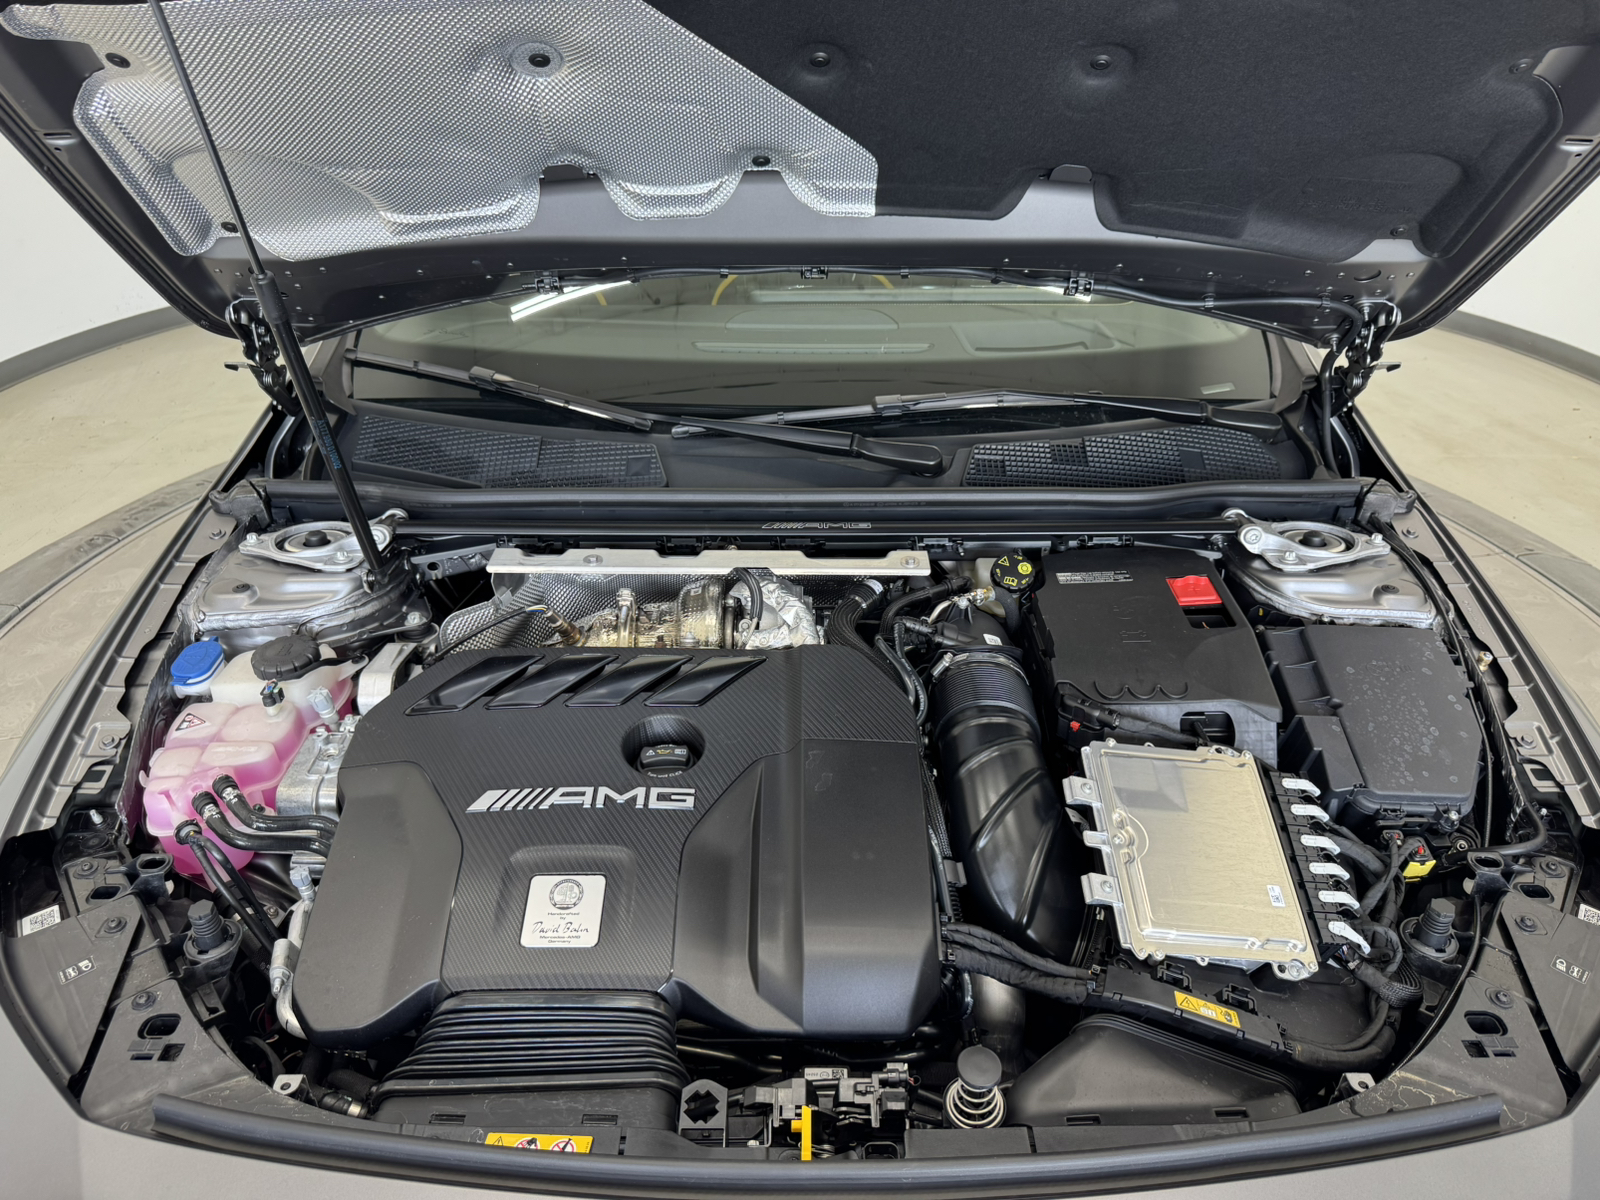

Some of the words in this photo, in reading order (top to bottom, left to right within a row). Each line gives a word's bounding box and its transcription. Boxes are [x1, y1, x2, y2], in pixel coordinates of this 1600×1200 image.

[797, 521, 872, 529] AMG
[538, 786, 696, 810] AMG
[531, 921, 561, 934] David
